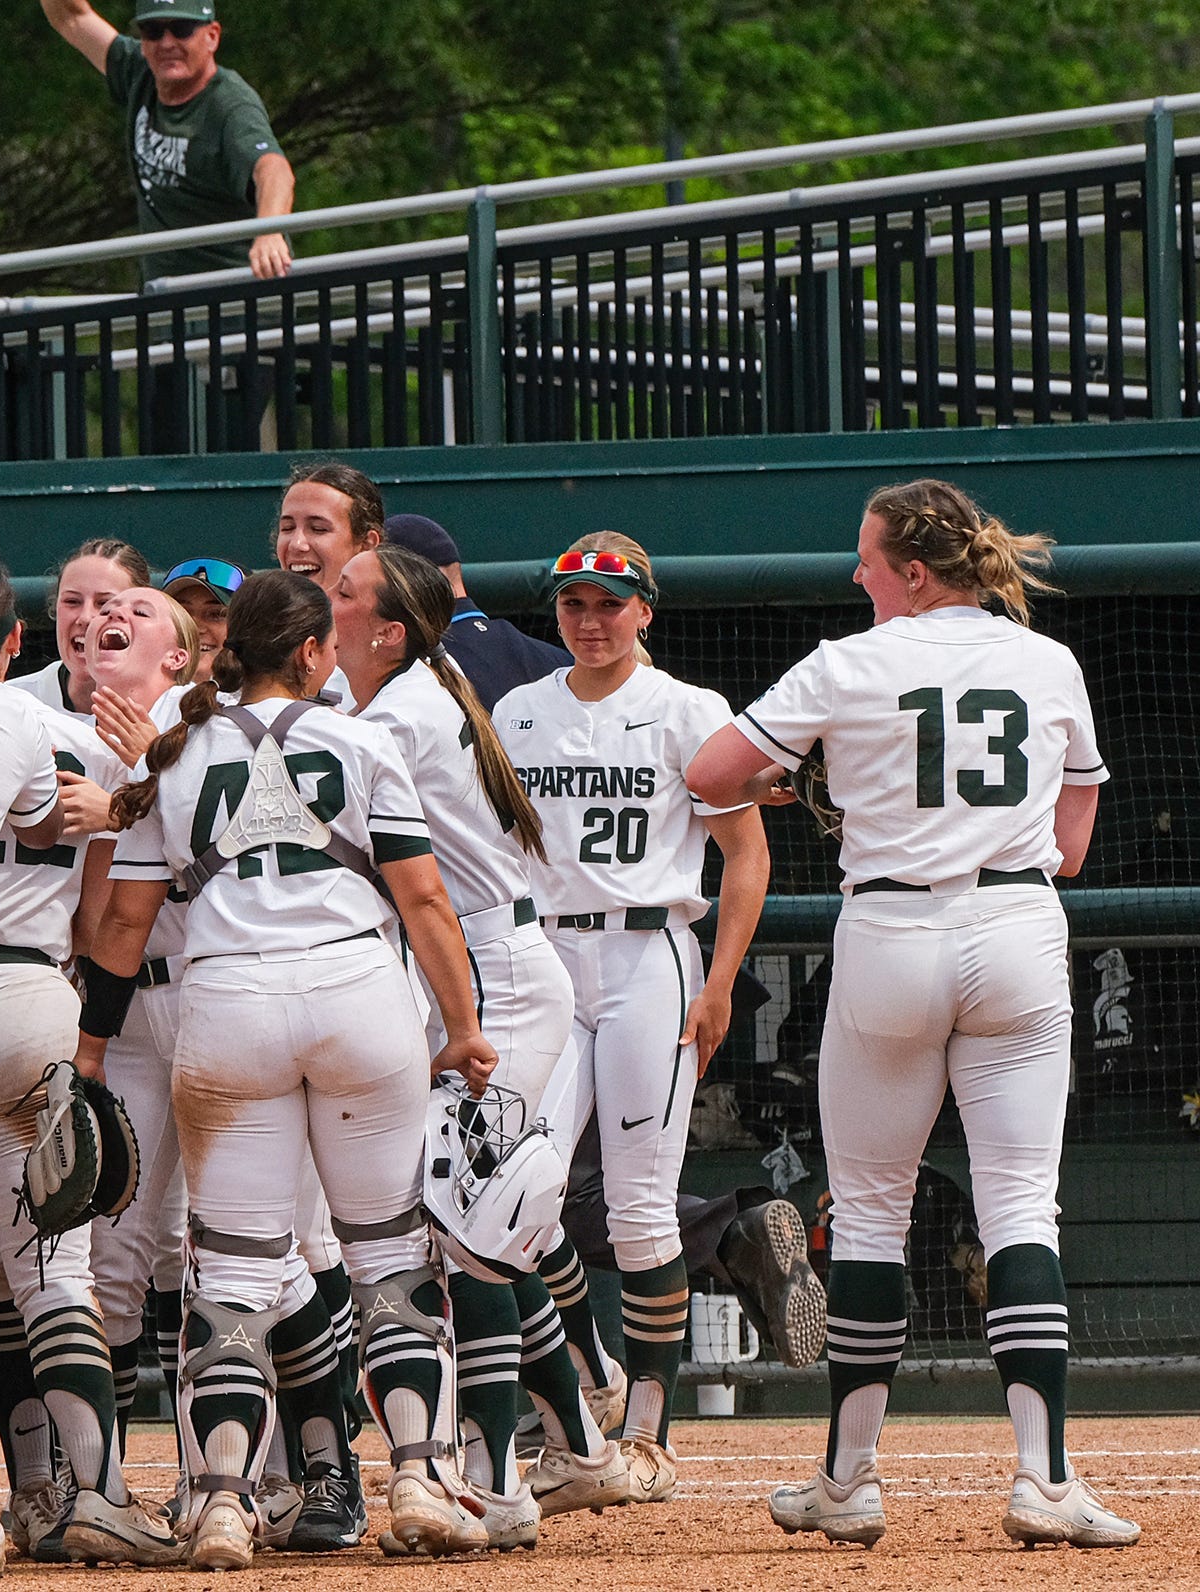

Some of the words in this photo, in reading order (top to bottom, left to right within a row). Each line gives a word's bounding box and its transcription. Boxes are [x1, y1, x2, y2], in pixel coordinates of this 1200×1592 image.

[898, 687, 1029, 808] 13
[190, 750, 346, 880] 42
[579, 807, 649, 864] 20
[54, 1121, 68, 1168] marucc
